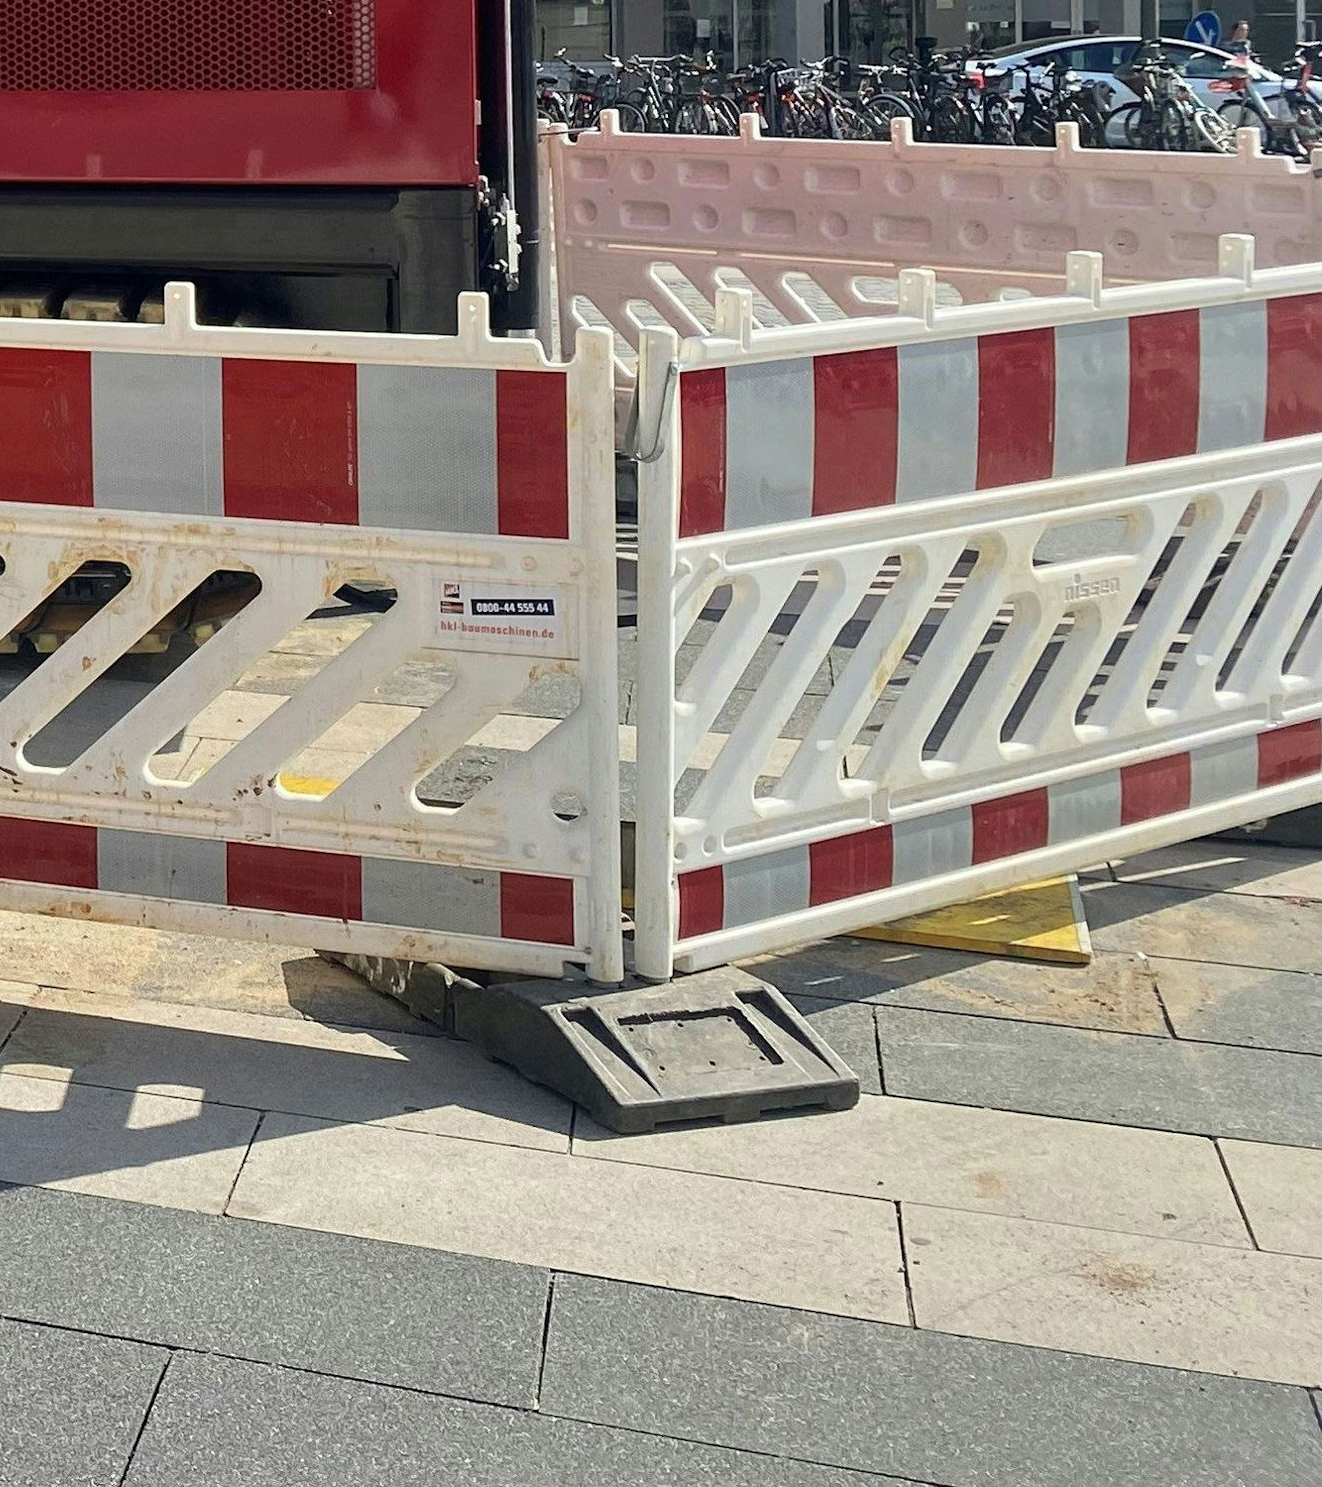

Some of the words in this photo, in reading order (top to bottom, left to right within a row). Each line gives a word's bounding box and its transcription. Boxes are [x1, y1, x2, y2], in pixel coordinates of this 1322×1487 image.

[1064, 573, 1120, 602] nissen
[475, 602, 515, 613] 0800-44
[517, 602, 535, 613] 555
[536, 602, 549, 613] 44
[440, 620, 555, 639] hkl-baumaschinen.de
